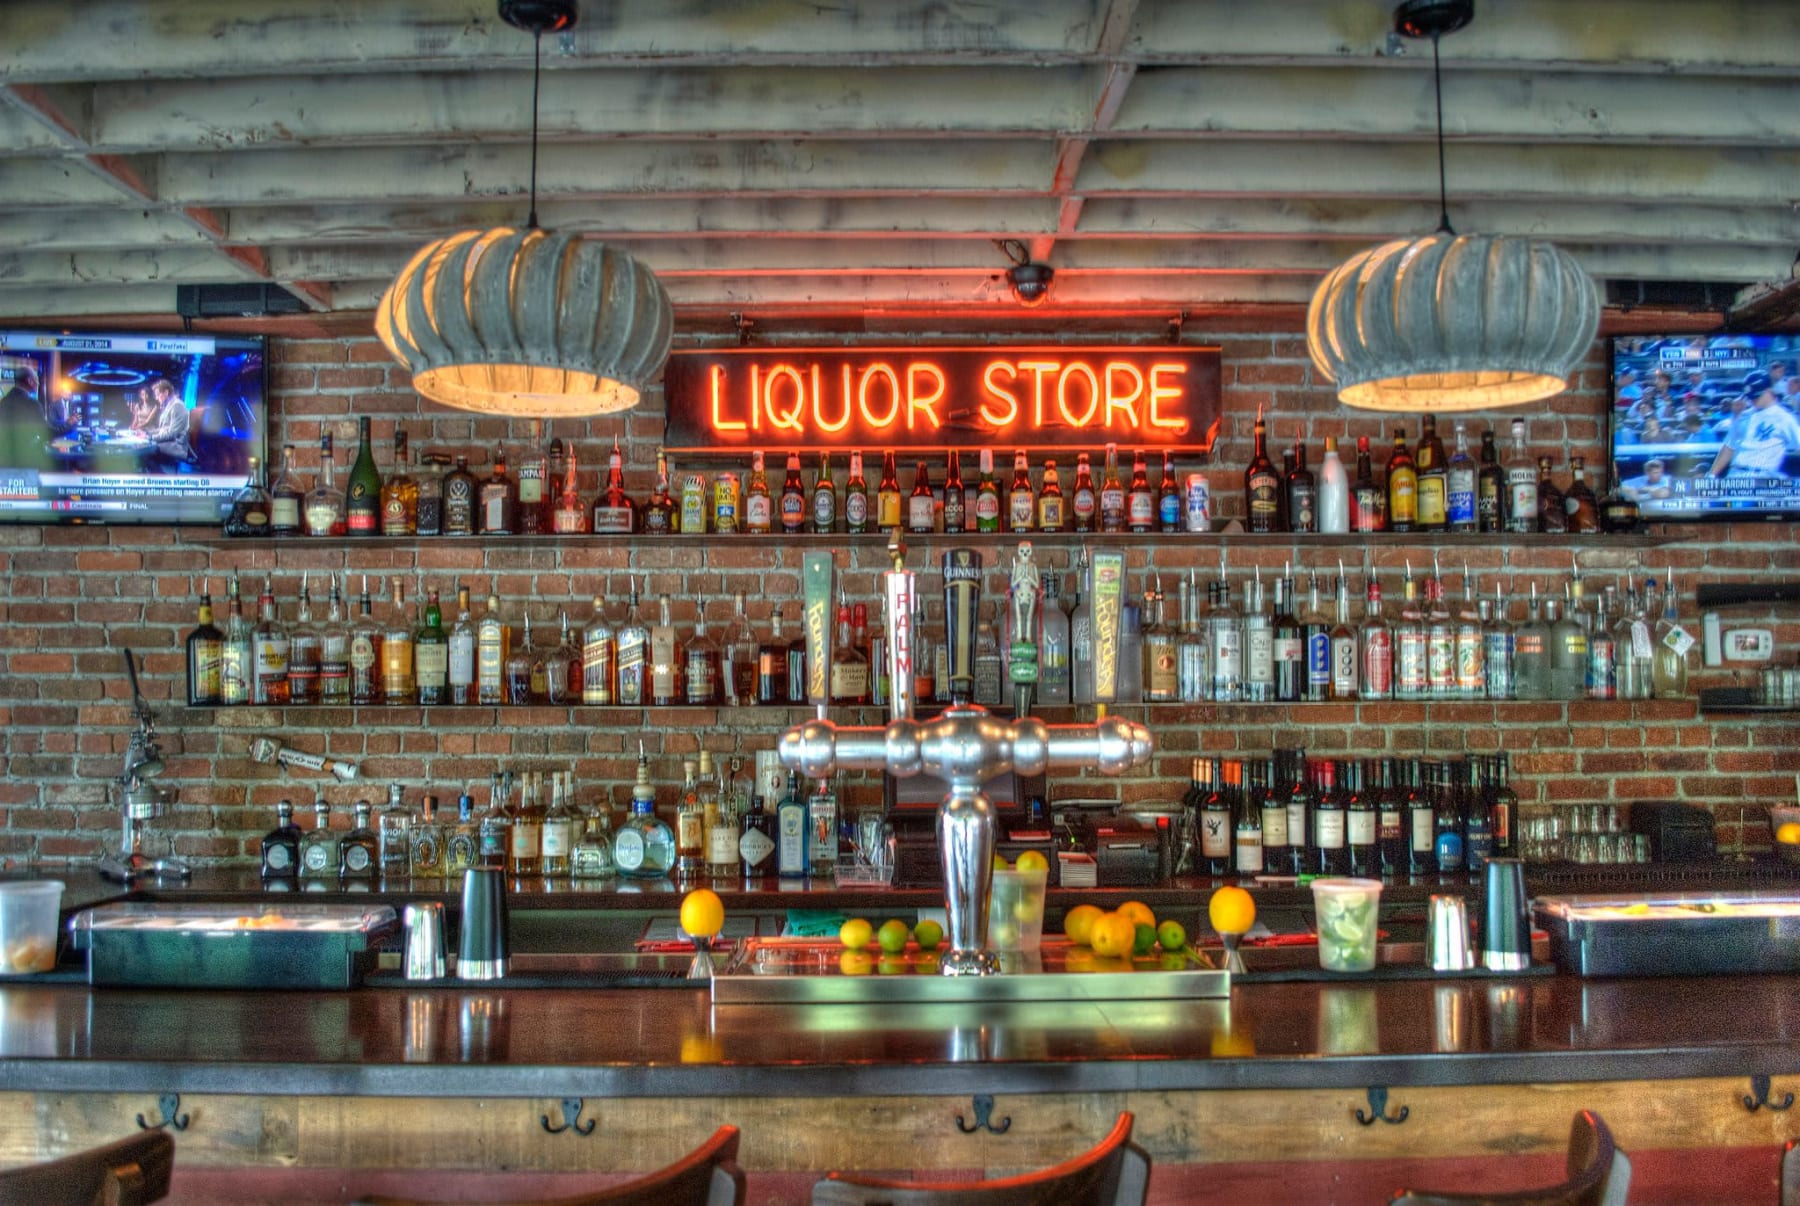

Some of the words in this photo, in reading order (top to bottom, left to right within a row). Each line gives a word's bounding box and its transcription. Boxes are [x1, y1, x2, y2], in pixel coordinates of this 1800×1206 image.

[63, 340, 84, 348] AUGUST
[711, 363, 946, 432] LIQUOR
[981, 361, 1188, 430] STORE
[8, 478, 25, 488] FOR
[82, 477, 101, 485] Brian
[101, 477, 121, 487] Hoyer
[147, 478, 173, 486] Browns
[173, 479, 200, 488] starting
[1695, 478, 1719, 488] BRETT
[1720, 478, 1756, 488] GARDNER
[0, 487, 39, 495] STARTERS
[84, 488, 115, 497] pressure
[125, 488, 145, 497] Hoyer
[146, 488, 163, 496] after
[163, 488, 183, 497] being
[183, 488, 208, 496] named
[208, 488, 234, 497] starter?
[896, 593, 913, 674] PALM
